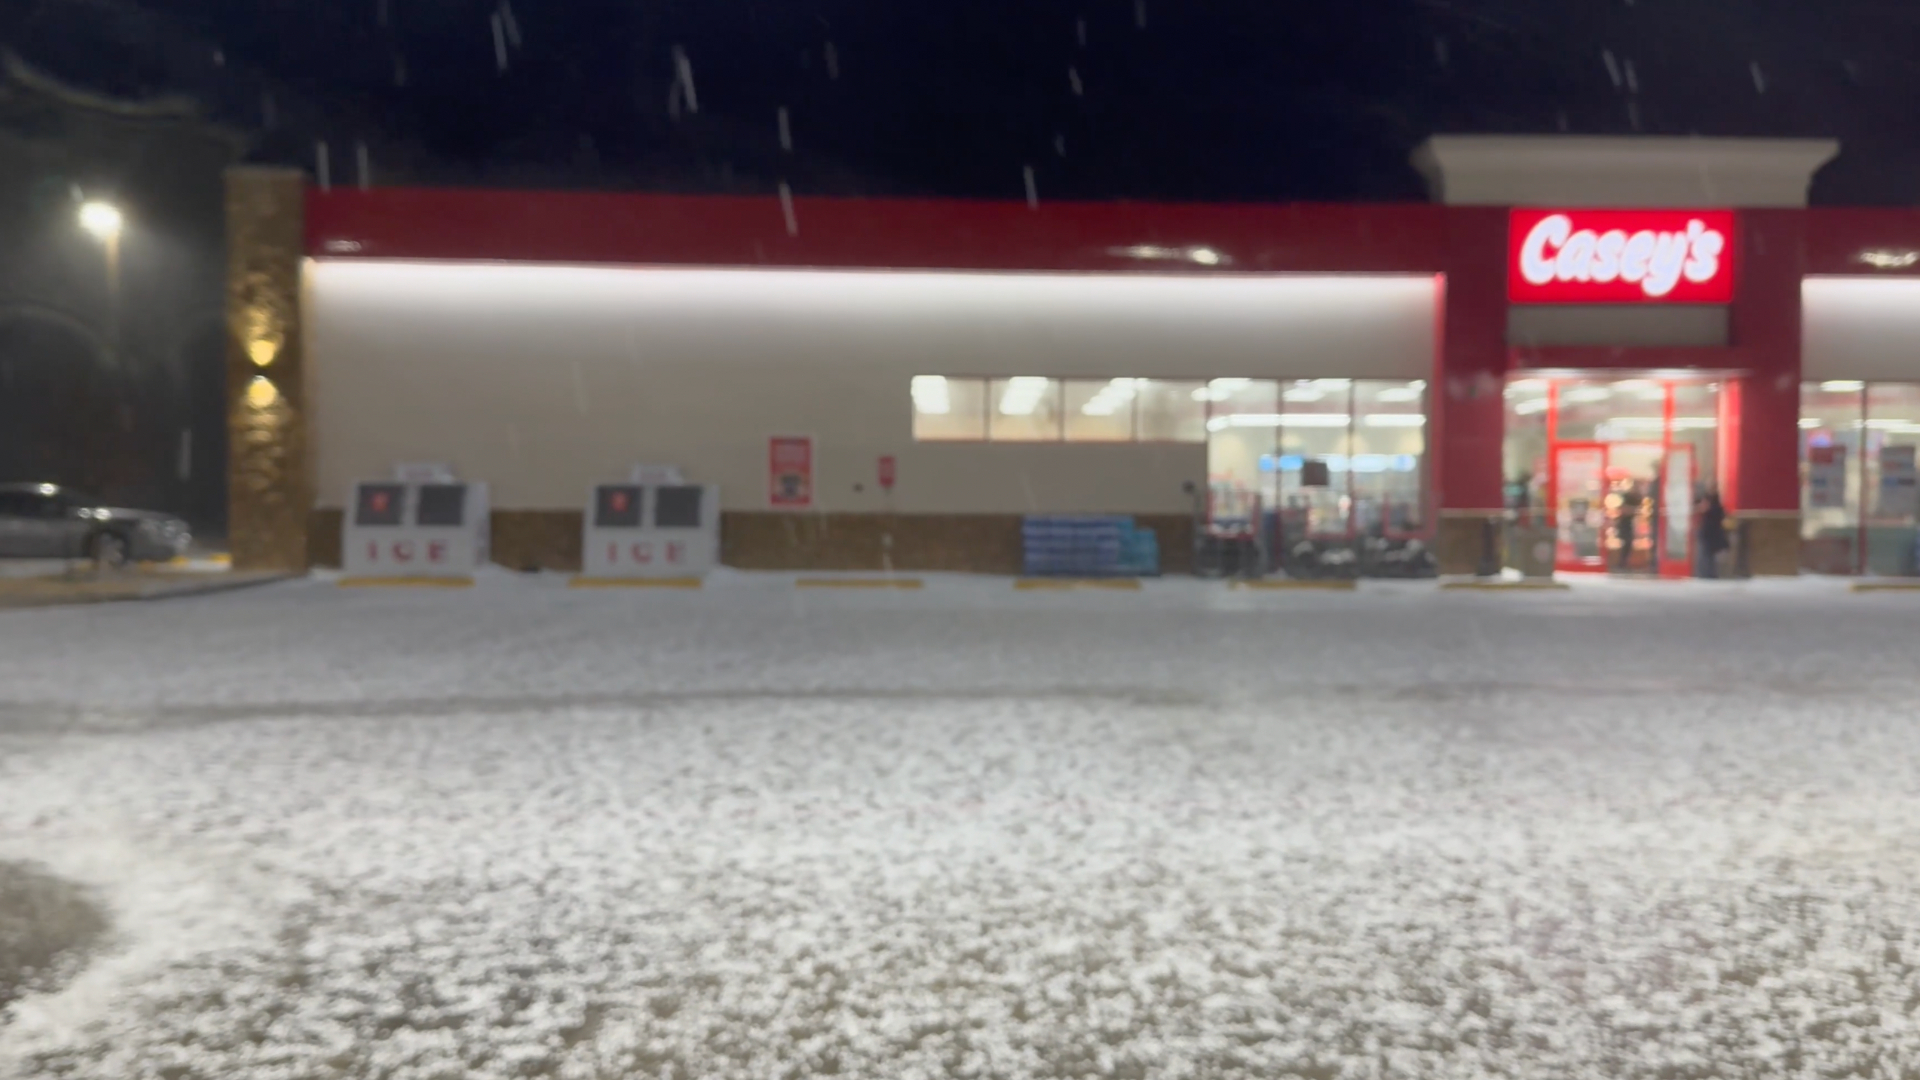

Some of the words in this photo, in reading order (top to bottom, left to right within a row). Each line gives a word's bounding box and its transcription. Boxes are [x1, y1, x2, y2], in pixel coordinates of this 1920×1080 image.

[1520, 213, 1725, 296] Casey's
[367, 539, 449, 563] ICE
[607, 541, 687, 564] ICE
